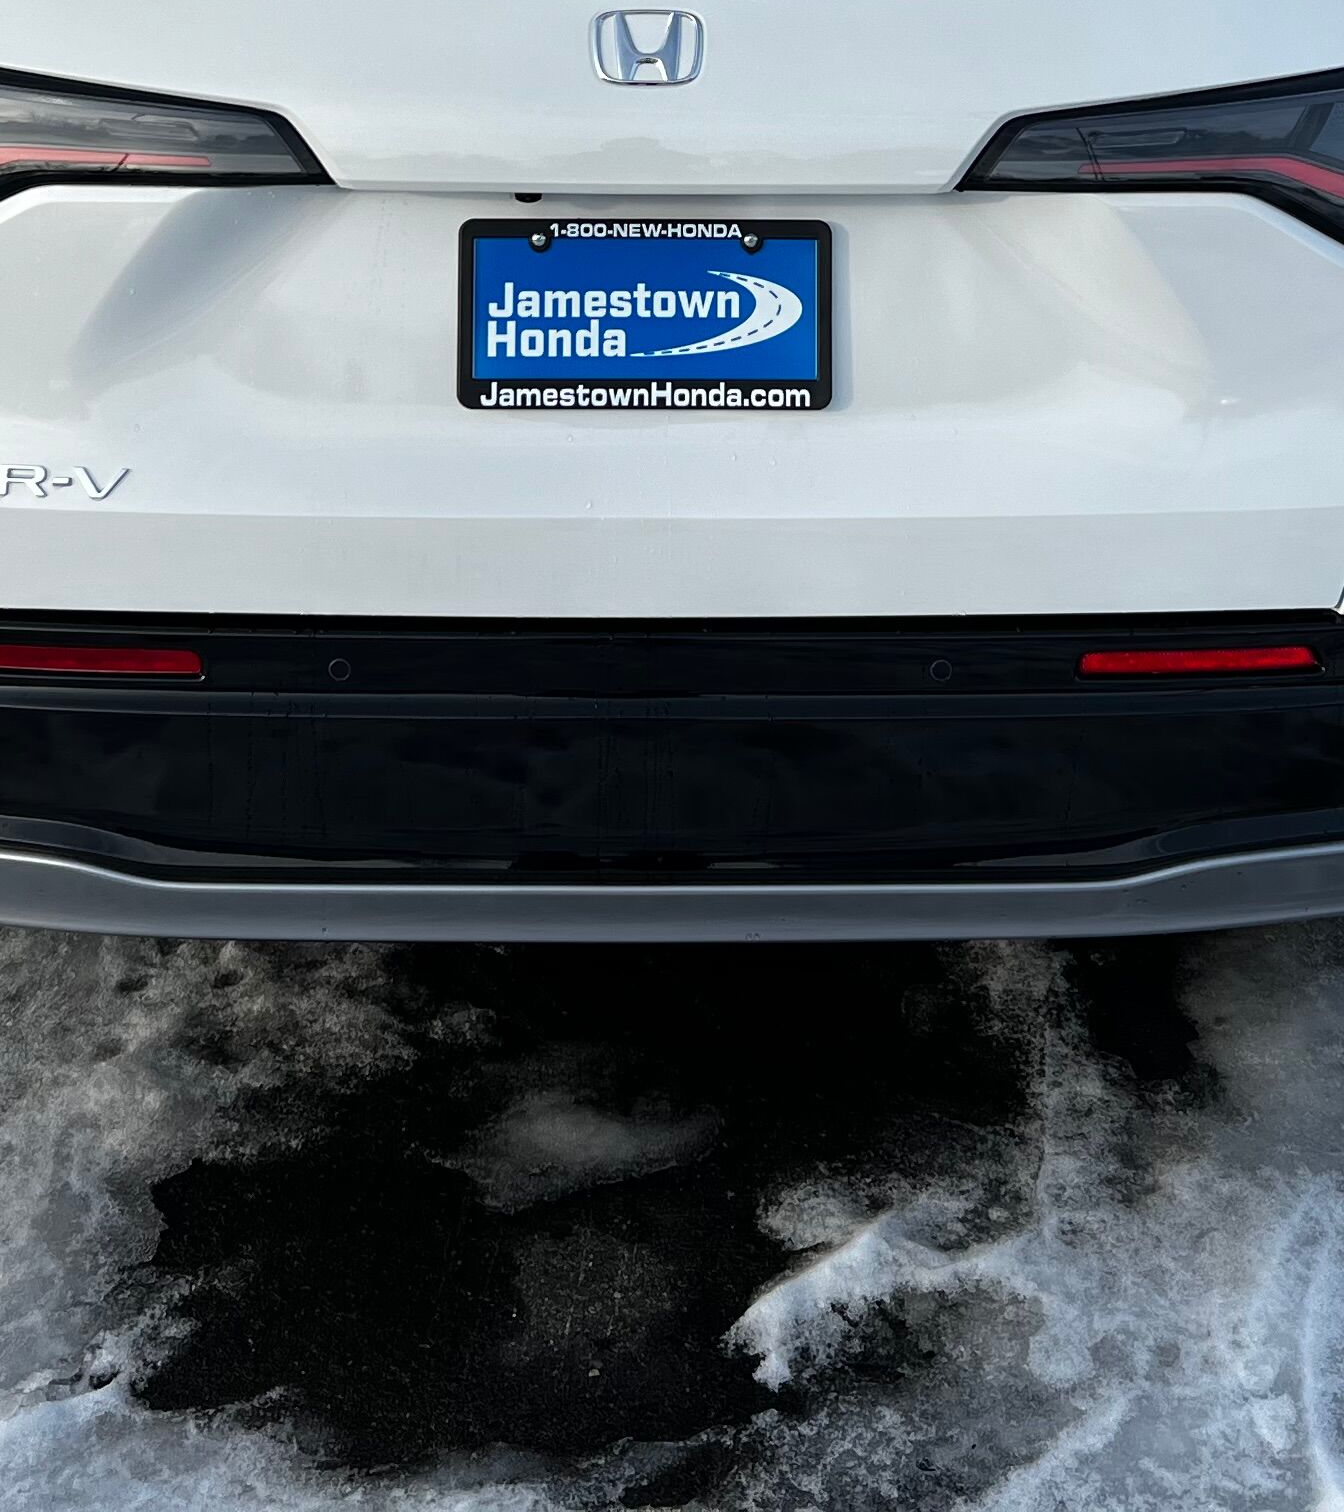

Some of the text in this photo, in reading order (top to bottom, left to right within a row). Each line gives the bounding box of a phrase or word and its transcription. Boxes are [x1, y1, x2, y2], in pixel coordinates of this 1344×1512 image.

[549, 222, 743, 239] 1-800-NEW-HONDA
[488, 282, 740, 319] Jamestown
[487, 320, 628, 358] Honda
[479, 381, 811, 408] JamestownHonda.com
